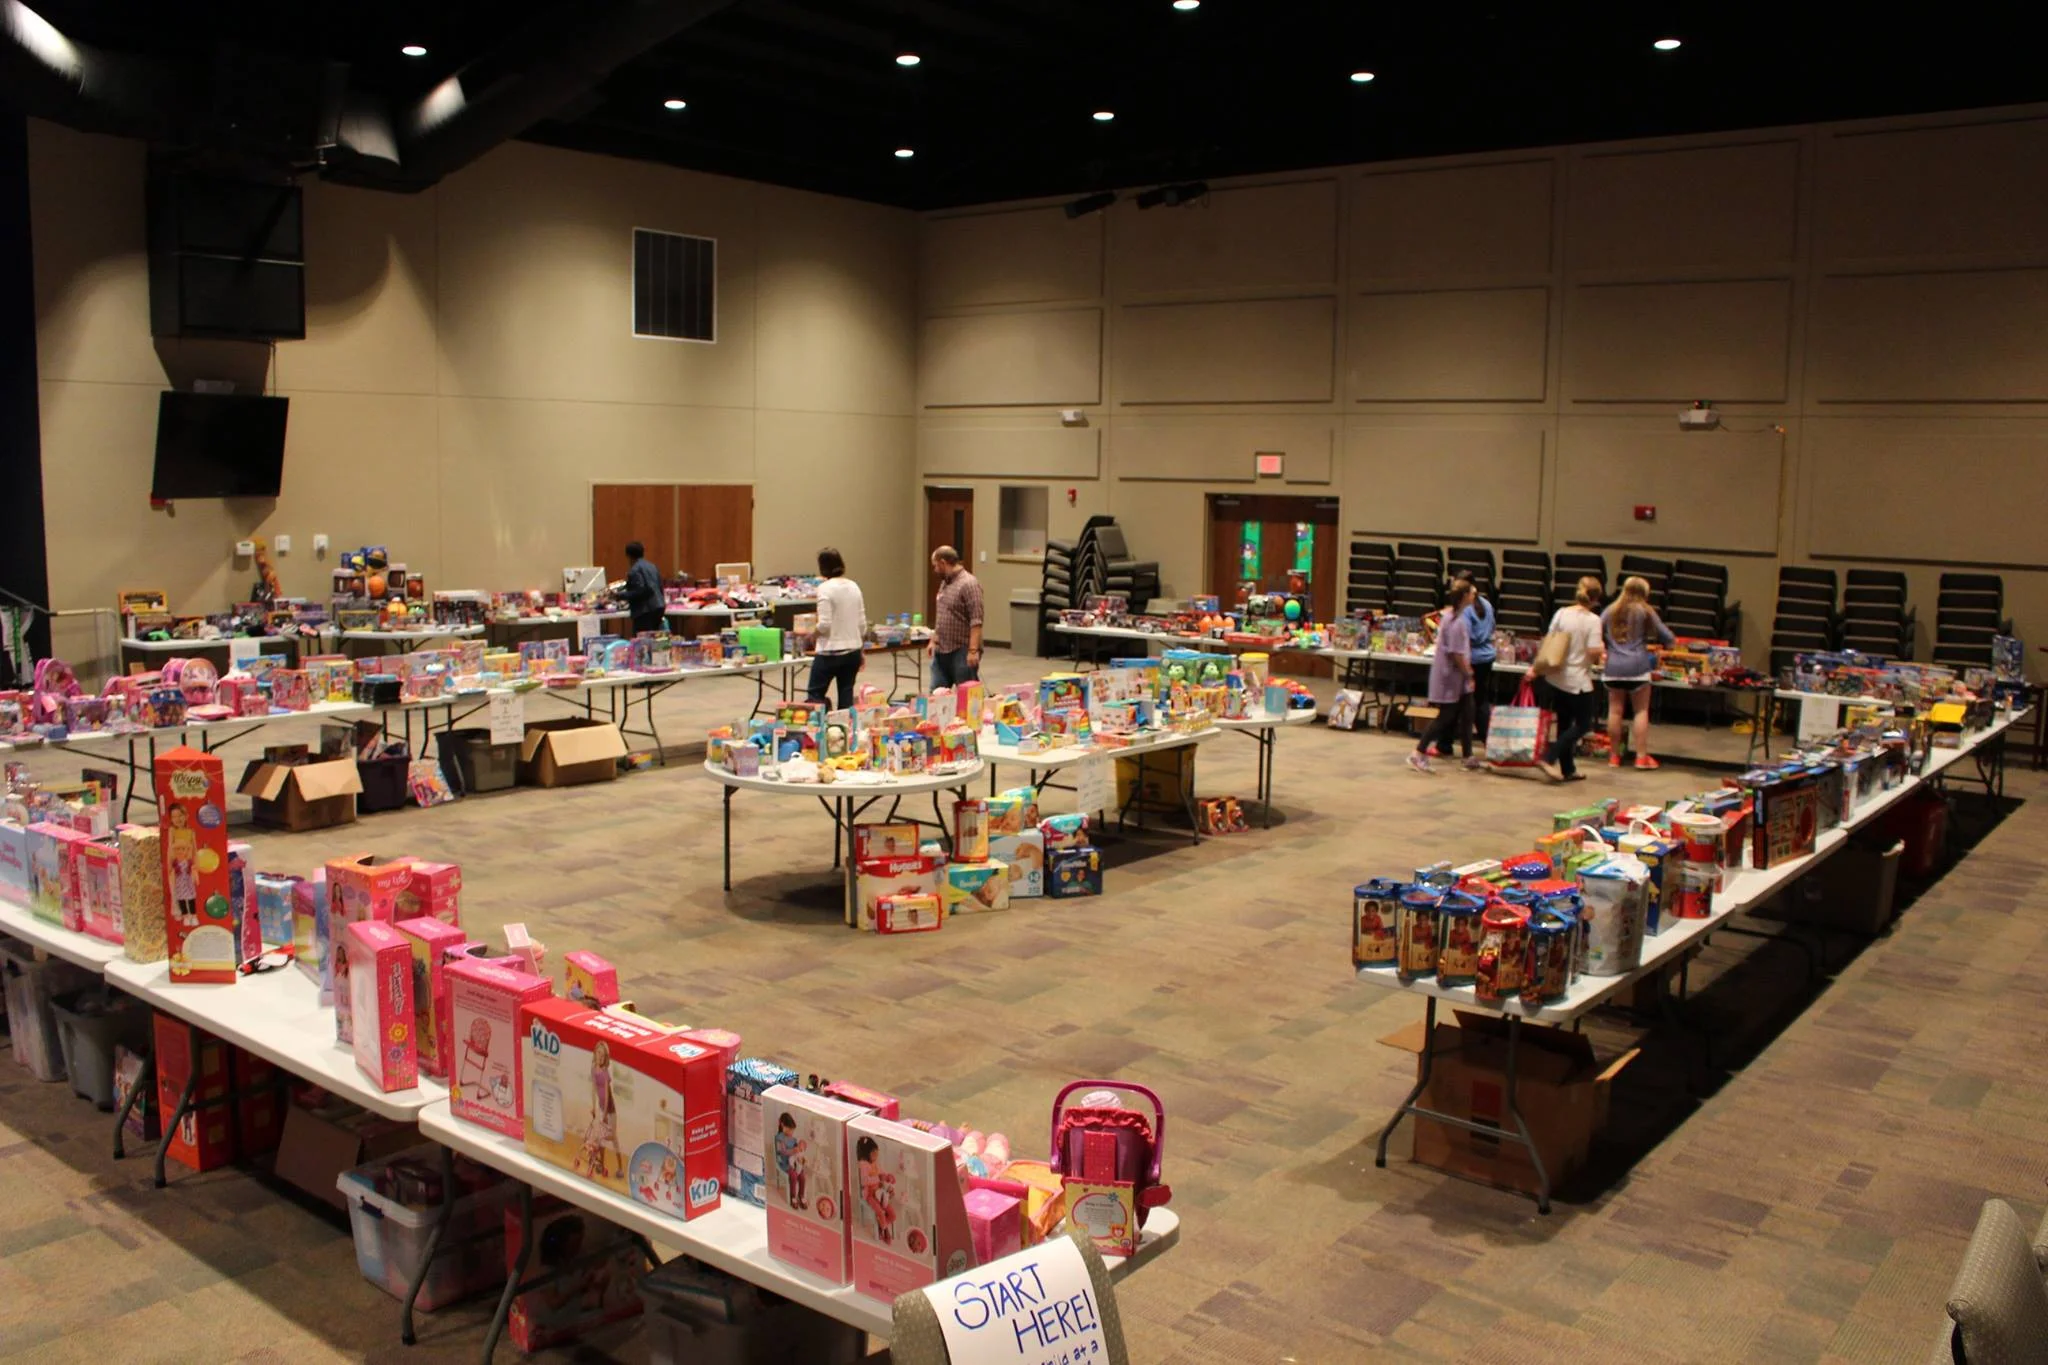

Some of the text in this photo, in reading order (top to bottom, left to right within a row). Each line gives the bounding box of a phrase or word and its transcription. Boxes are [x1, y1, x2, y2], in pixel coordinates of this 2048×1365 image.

[532, 1027, 560, 1056] KID
[690, 1180, 718, 1201] KID
[954, 1263, 1046, 1330] START
[1012, 1288, 1097, 1354] HERE!
[1090, 1340, 1098, 1354] a
